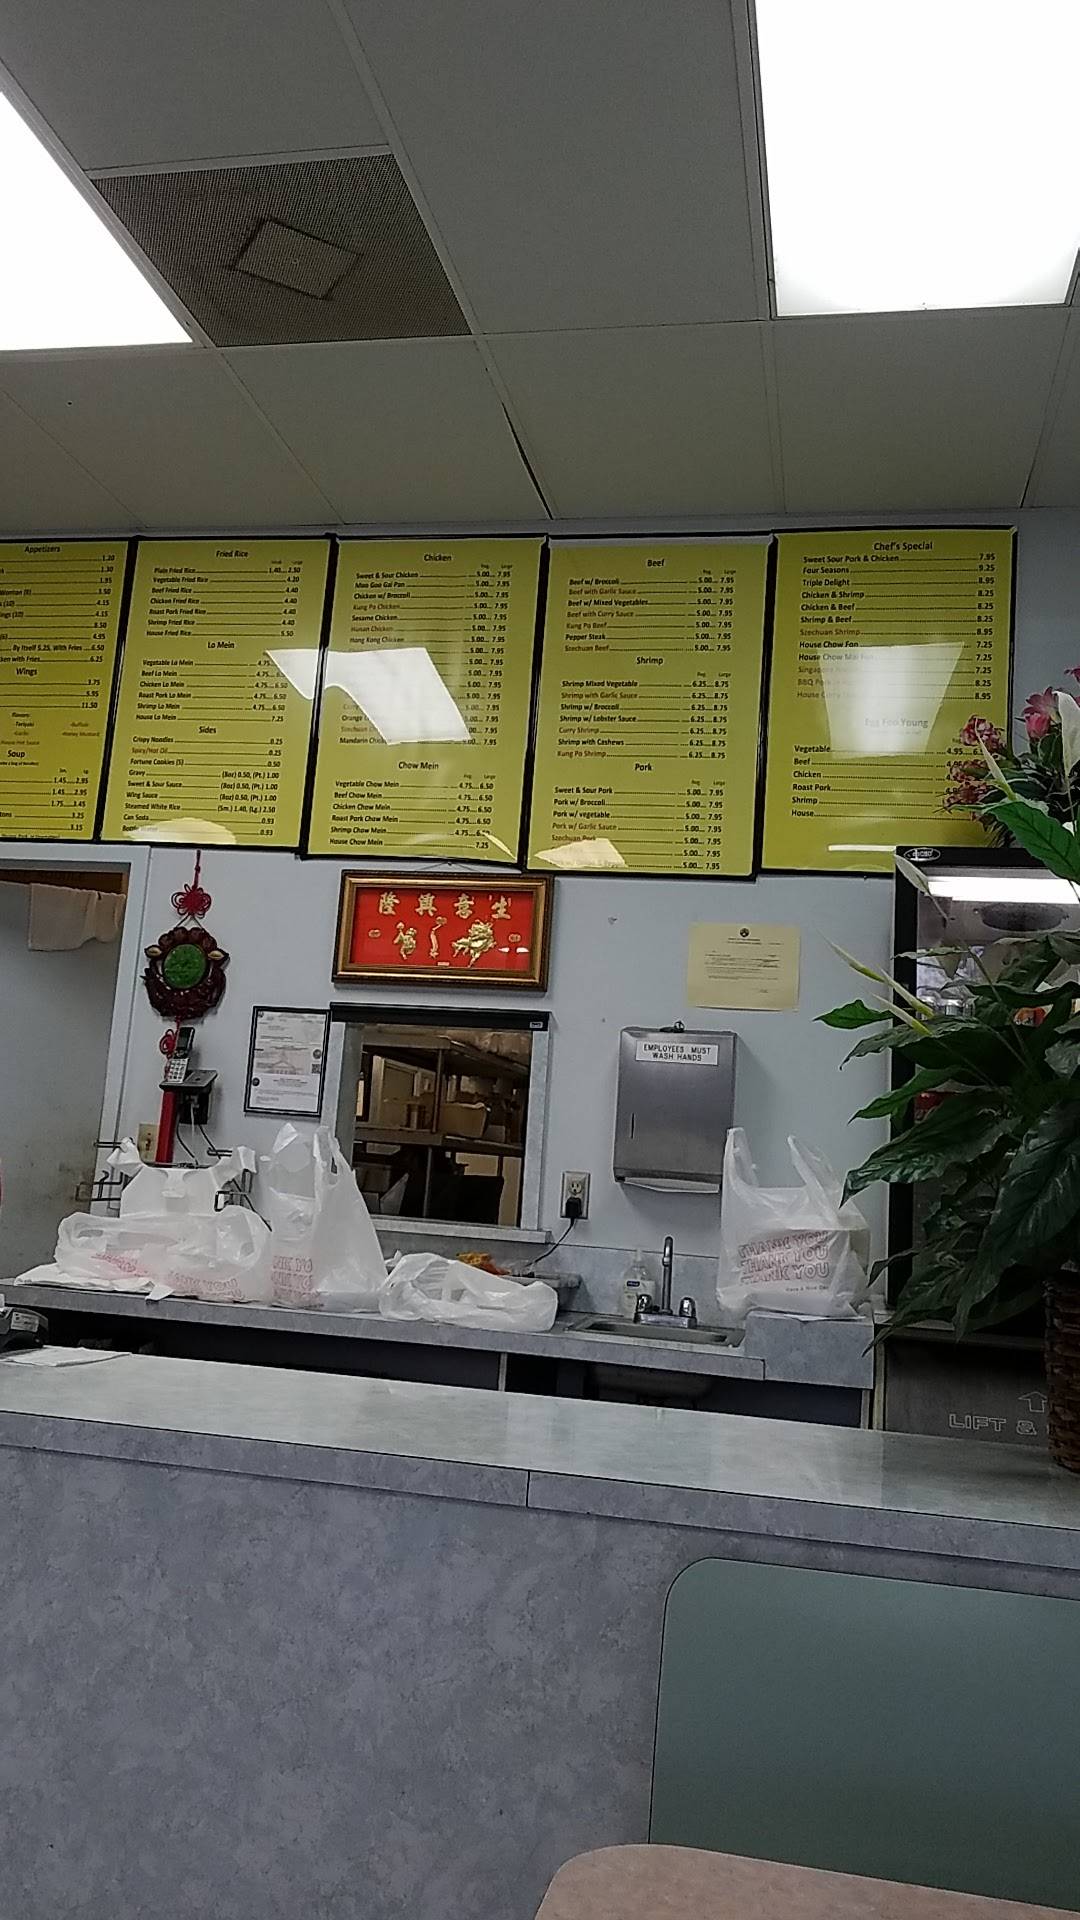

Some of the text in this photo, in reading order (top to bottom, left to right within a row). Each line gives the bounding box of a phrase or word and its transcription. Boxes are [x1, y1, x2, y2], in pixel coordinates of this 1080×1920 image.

[874, 542, 932, 550] Chef's Special
[614, 599, 648, 607] Vegetables
[636, 657, 663, 665] Shrimp
[794, 745, 830, 754] Vegetable
[792, 797, 818, 805] Shrimp
[643, 1043, 711, 1055] EMPLOYEES MUST
[652, 1052, 702, 1062] WASH HANDS
[740, 1246, 828, 1275] THANK YOU
[791, 1262, 829, 1279] YOU
[949, 1413, 1007, 1432] LIFT
